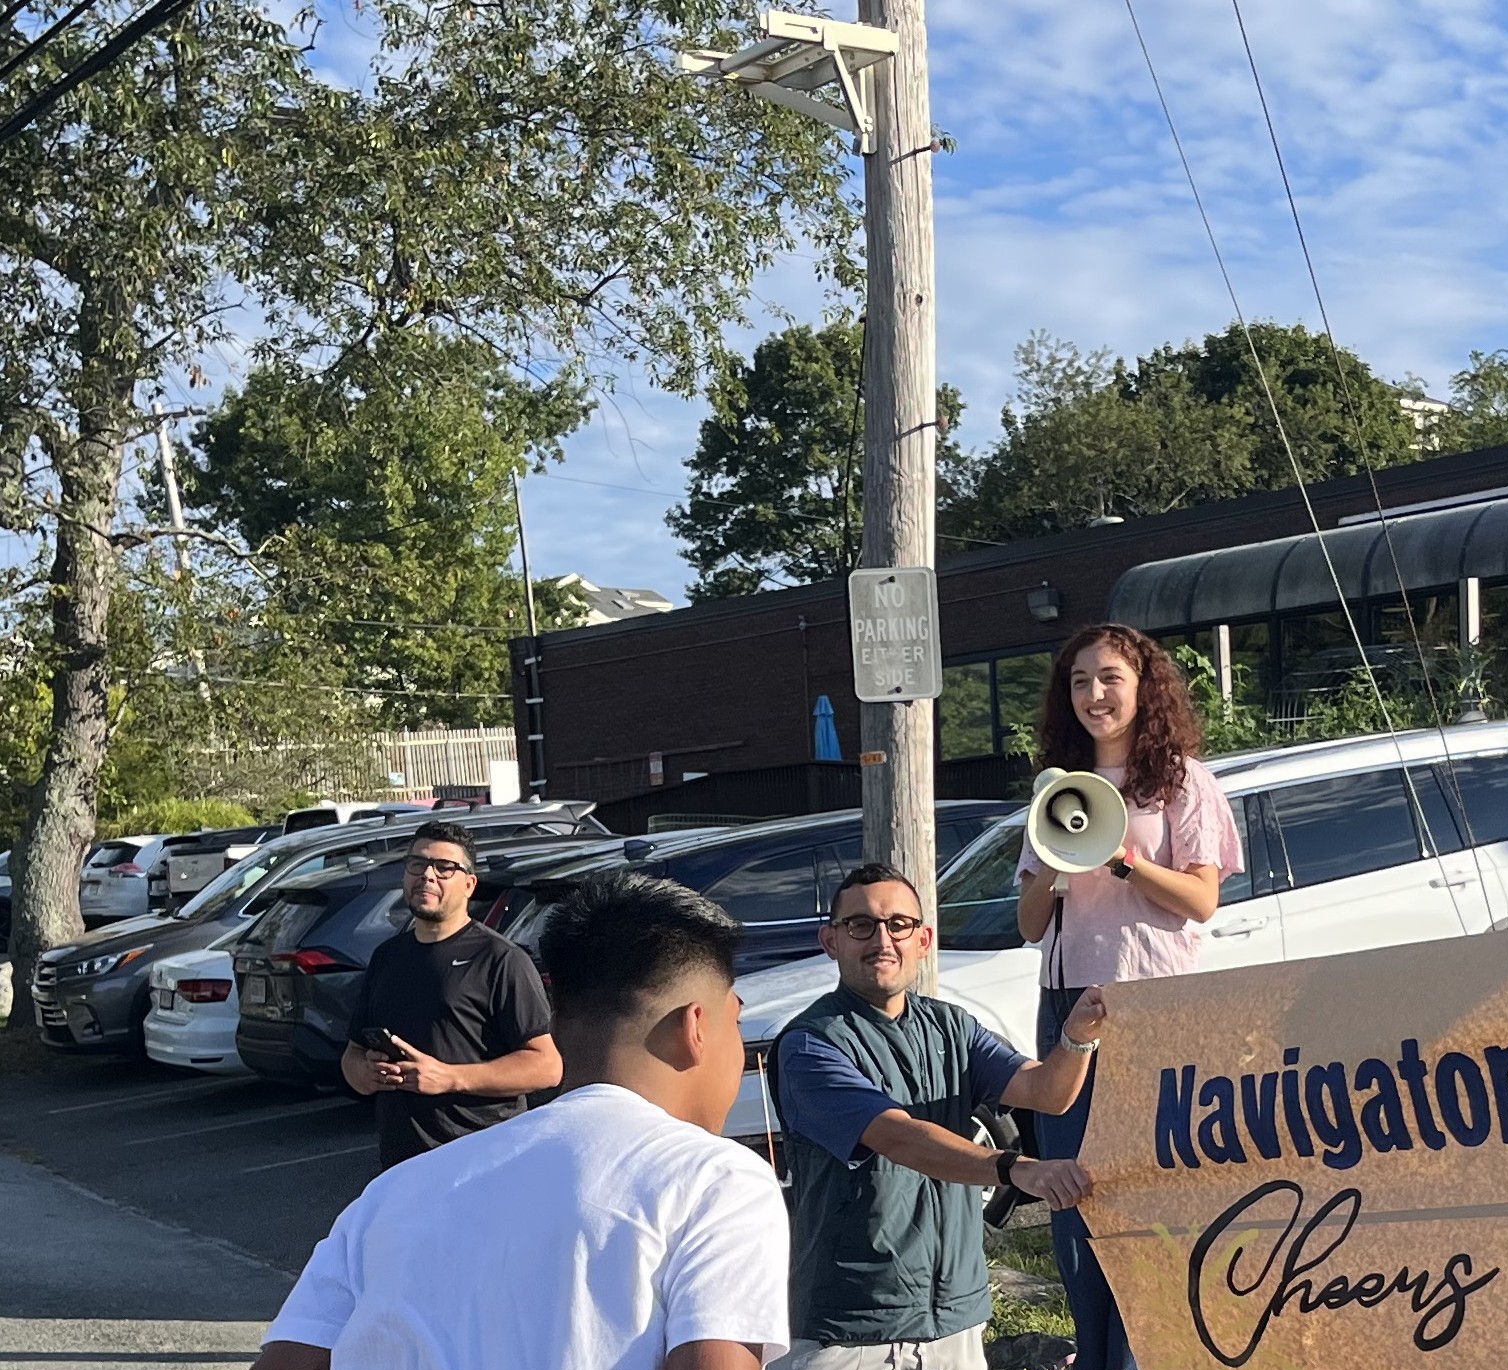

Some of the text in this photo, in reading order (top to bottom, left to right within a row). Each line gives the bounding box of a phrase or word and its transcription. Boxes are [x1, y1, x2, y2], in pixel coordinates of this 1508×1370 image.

[874, 584, 906, 609] NO
[855, 616, 929, 643] PARKING
[861, 646, 925, 665] EITER
[874, 668, 916, 686] SIDE
[1187, 1179, 1501, 1369] Cheers
